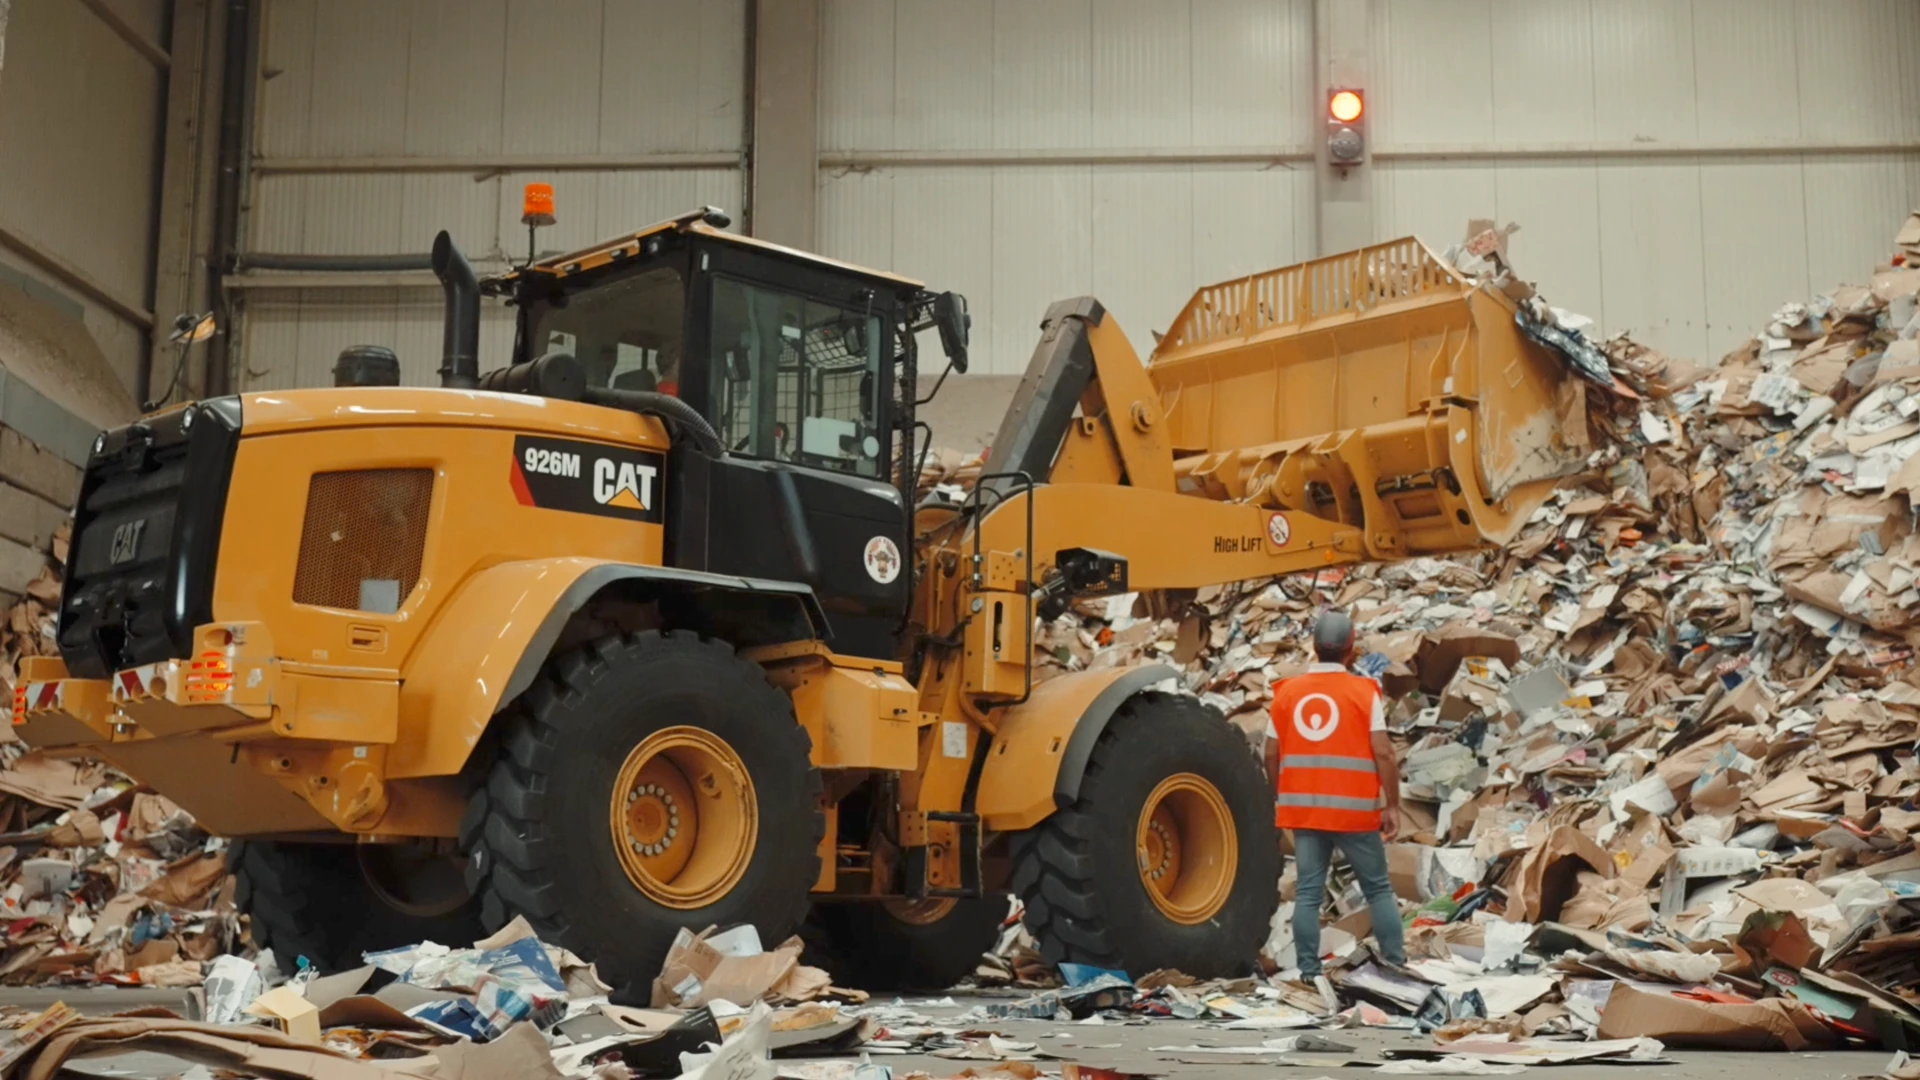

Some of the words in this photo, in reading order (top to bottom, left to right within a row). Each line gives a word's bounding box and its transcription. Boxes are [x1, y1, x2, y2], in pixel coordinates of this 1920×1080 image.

[525, 447, 581, 478] 926M
[593, 458, 657, 511] CAT
[110, 519, 145, 565] CAT
